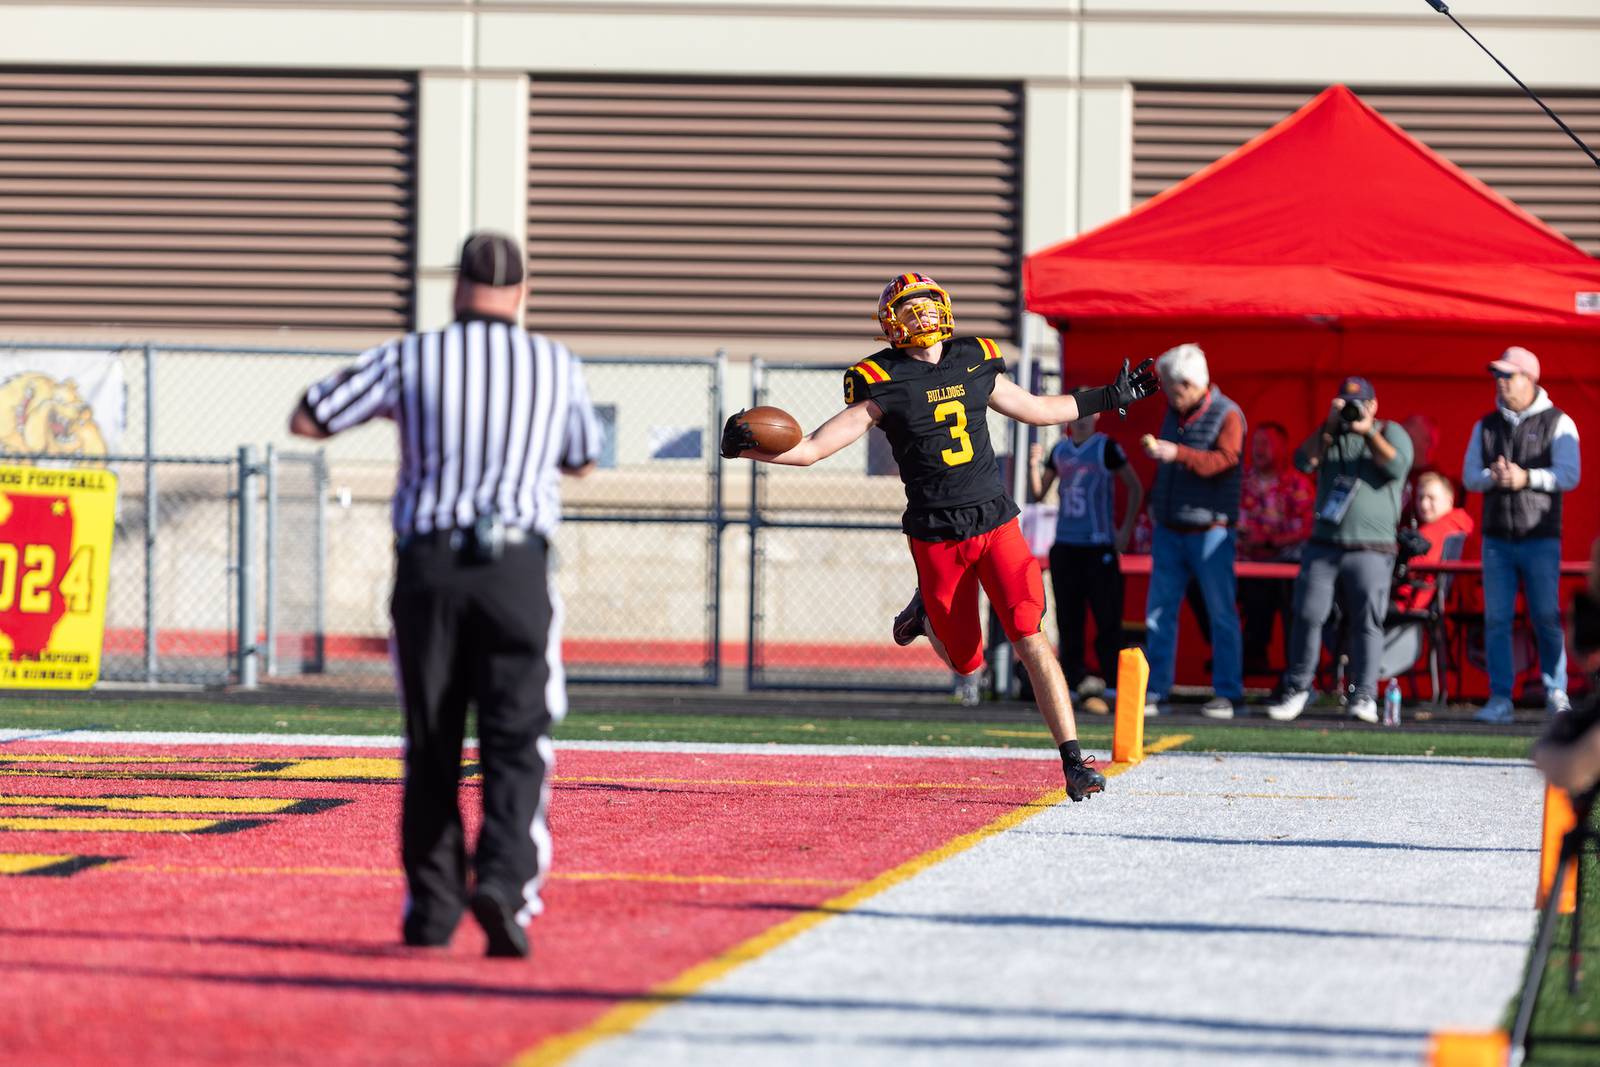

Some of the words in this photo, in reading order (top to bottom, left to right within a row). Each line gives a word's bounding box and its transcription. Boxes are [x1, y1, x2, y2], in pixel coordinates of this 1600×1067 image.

[845, 377, 854, 403] 3
[926, 384, 965, 403] BULLDOGS
[934, 400, 974, 466] 3
[28, 473, 106, 490] FOOTBALL
